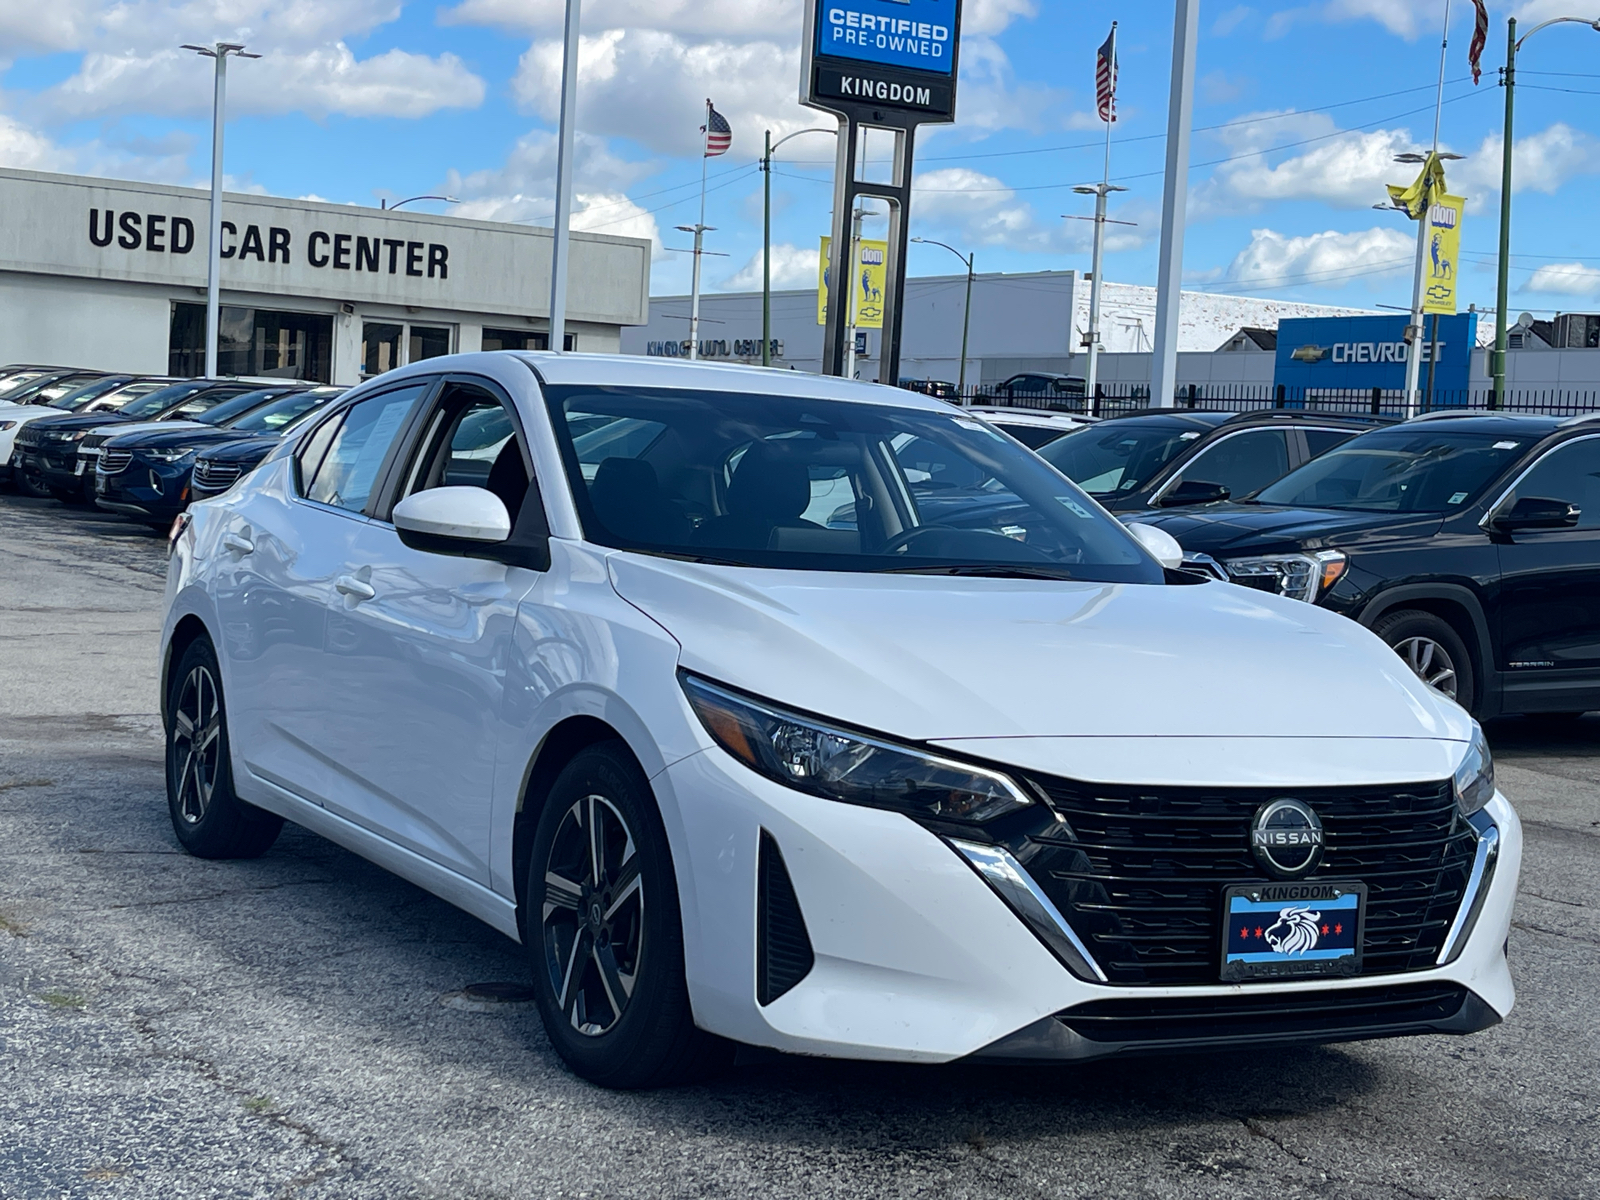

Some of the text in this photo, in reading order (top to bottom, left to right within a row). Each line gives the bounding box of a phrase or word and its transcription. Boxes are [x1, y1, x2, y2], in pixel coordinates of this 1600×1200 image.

[829, 8, 948, 42] CERTIFIED
[833, 27, 942, 57] PRE-OWNED
[841, 76, 931, 105] KINGDOM
[1432, 202, 1456, 228] dom
[89, 208, 450, 279] USED CAR CENTER
[861, 246, 883, 265] dom
[1332, 342, 1446, 363] CHEVROET
[1254, 832, 1321, 844] NISSAN
[1261, 886, 1334, 900] KINGDOM
